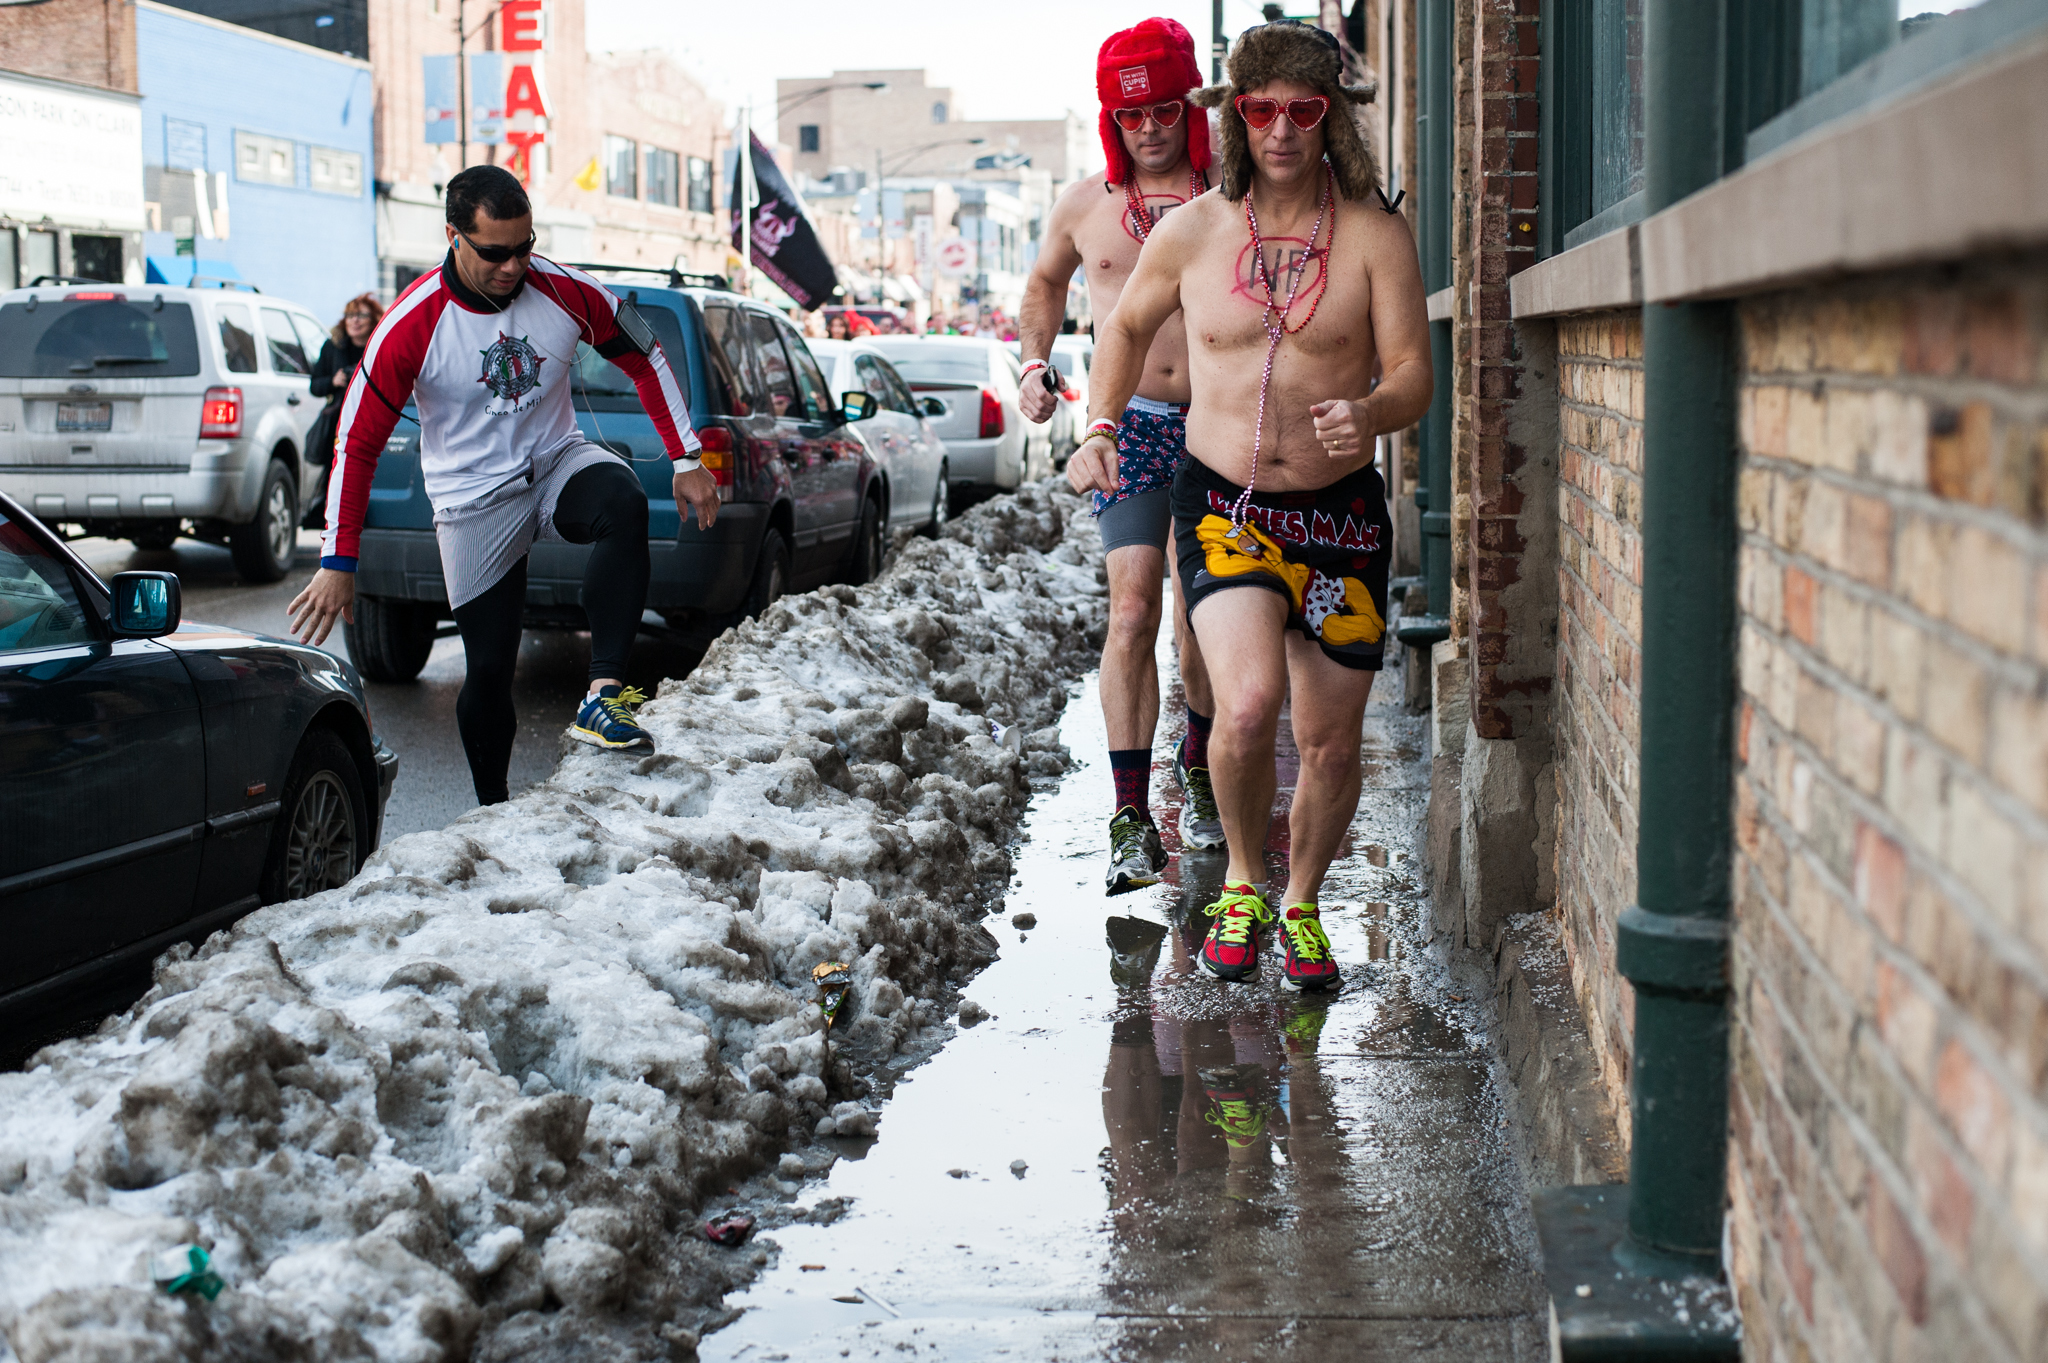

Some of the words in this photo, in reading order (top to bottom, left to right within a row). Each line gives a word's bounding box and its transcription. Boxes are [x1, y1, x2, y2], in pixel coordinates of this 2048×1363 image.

[502, 0, 547, 189] EAT
[1123, 77, 1146, 86] CUPID
[1249, 248, 1316, 293] NF
[485, 405, 509, 416] Cinco
[513, 404, 524, 414] de
[1311, 509, 1381, 551] MAN
